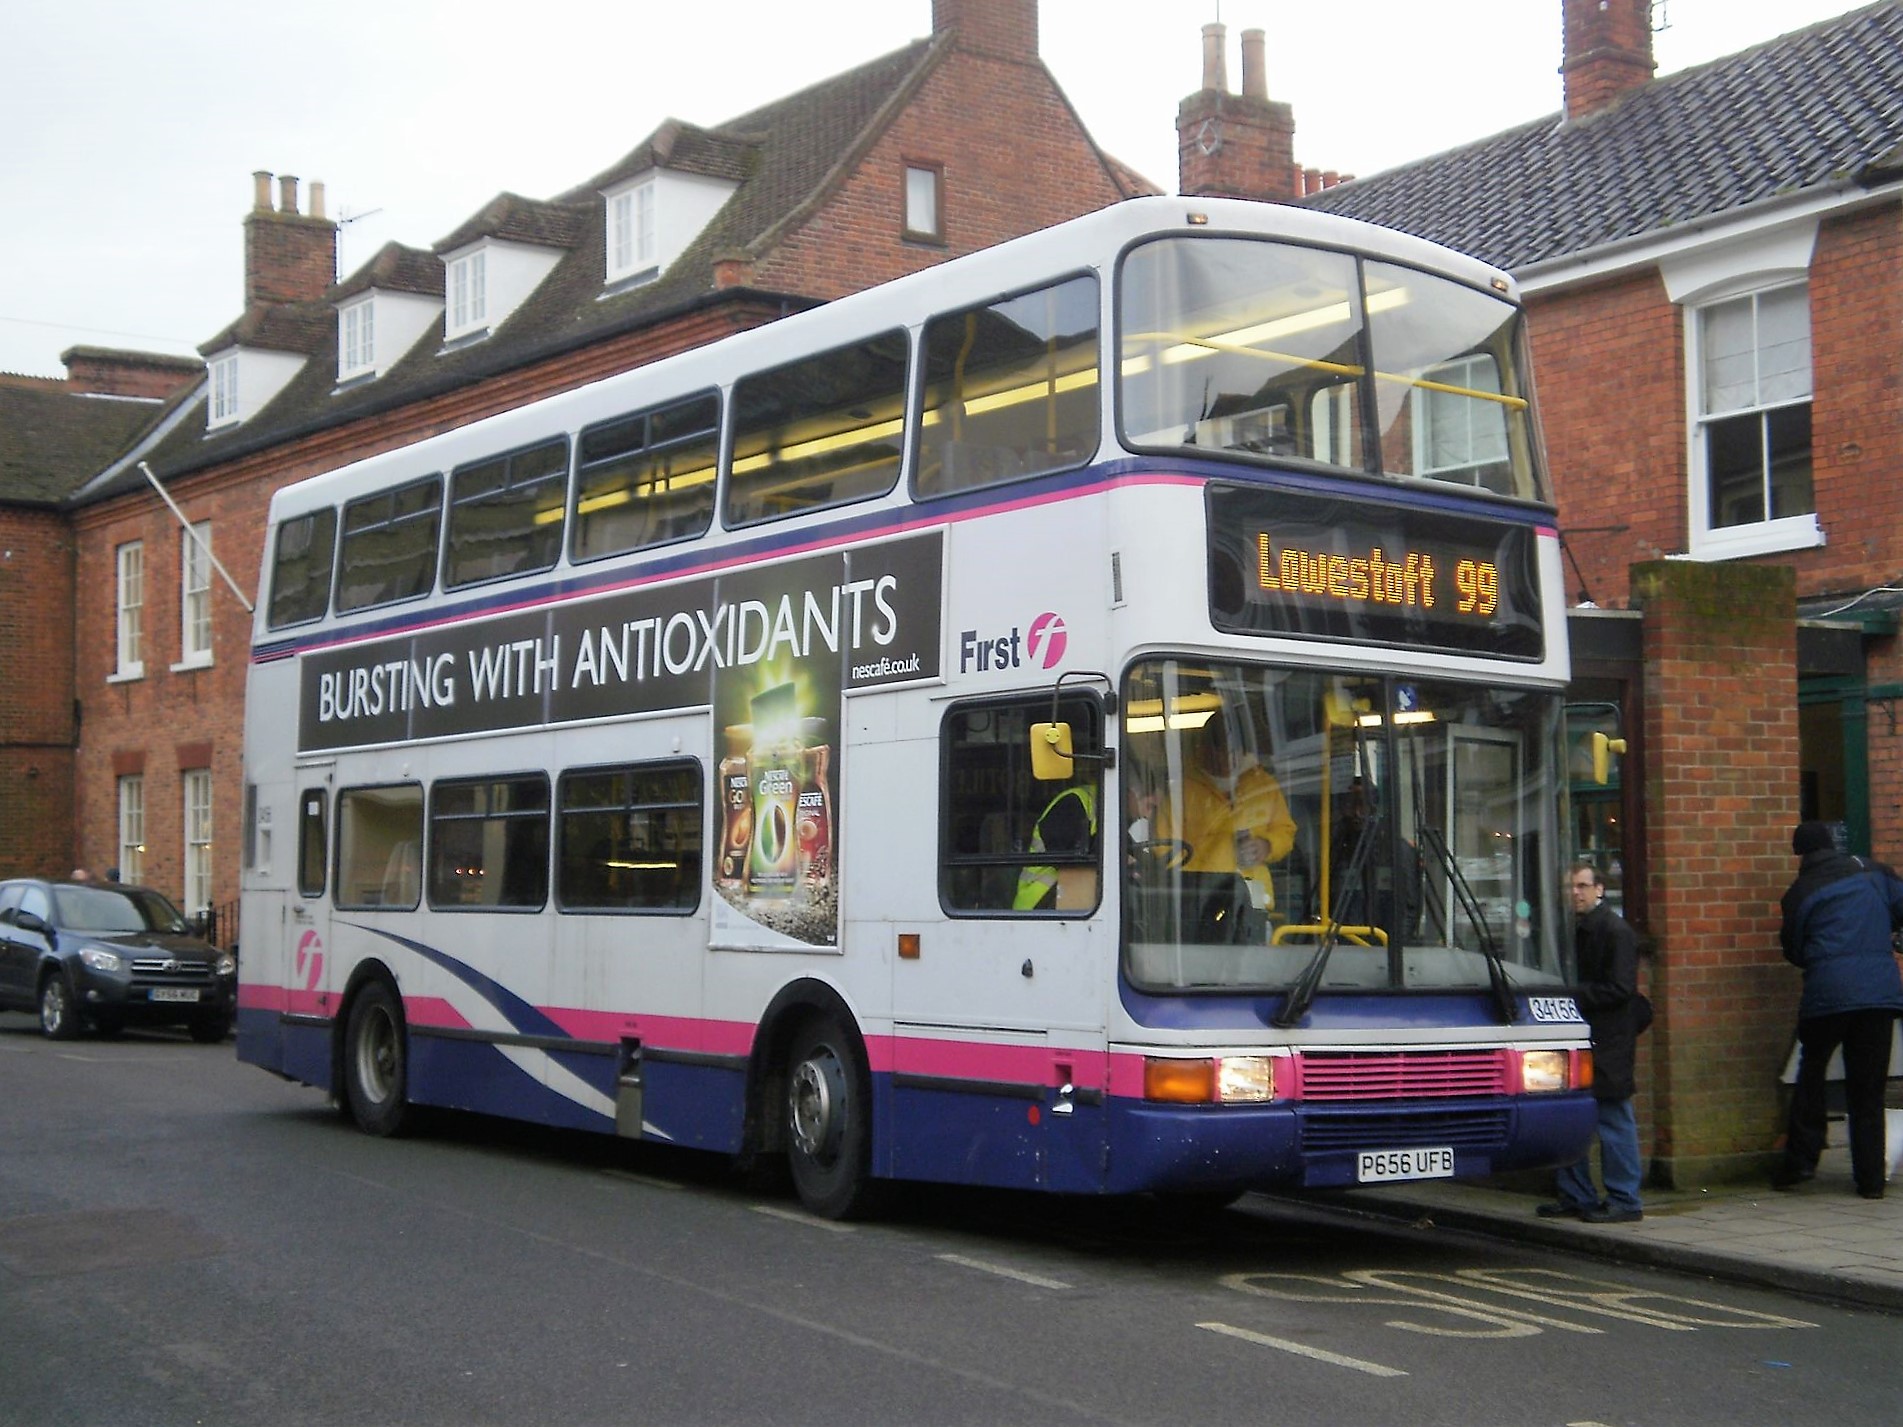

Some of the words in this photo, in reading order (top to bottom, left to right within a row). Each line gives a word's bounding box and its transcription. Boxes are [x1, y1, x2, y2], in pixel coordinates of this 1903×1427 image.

[1257, 530, 1435, 608] Lowestoft
[1456, 559, 1499, 614] 99
[319, 652, 455, 722] BURSTING
[468, 634, 560, 702] WITH
[571, 574, 897, 689] ANTIOXIDANTS
[960, 626, 1021, 674] First
[851, 652, 920, 680] nescafé.co.uk
[759, 780, 793, 796] Green
[1532, 999, 1580, 1020] 34156
[1362, 1153, 1412, 1177] P656
[1416, 1150, 1453, 1173] UFB
